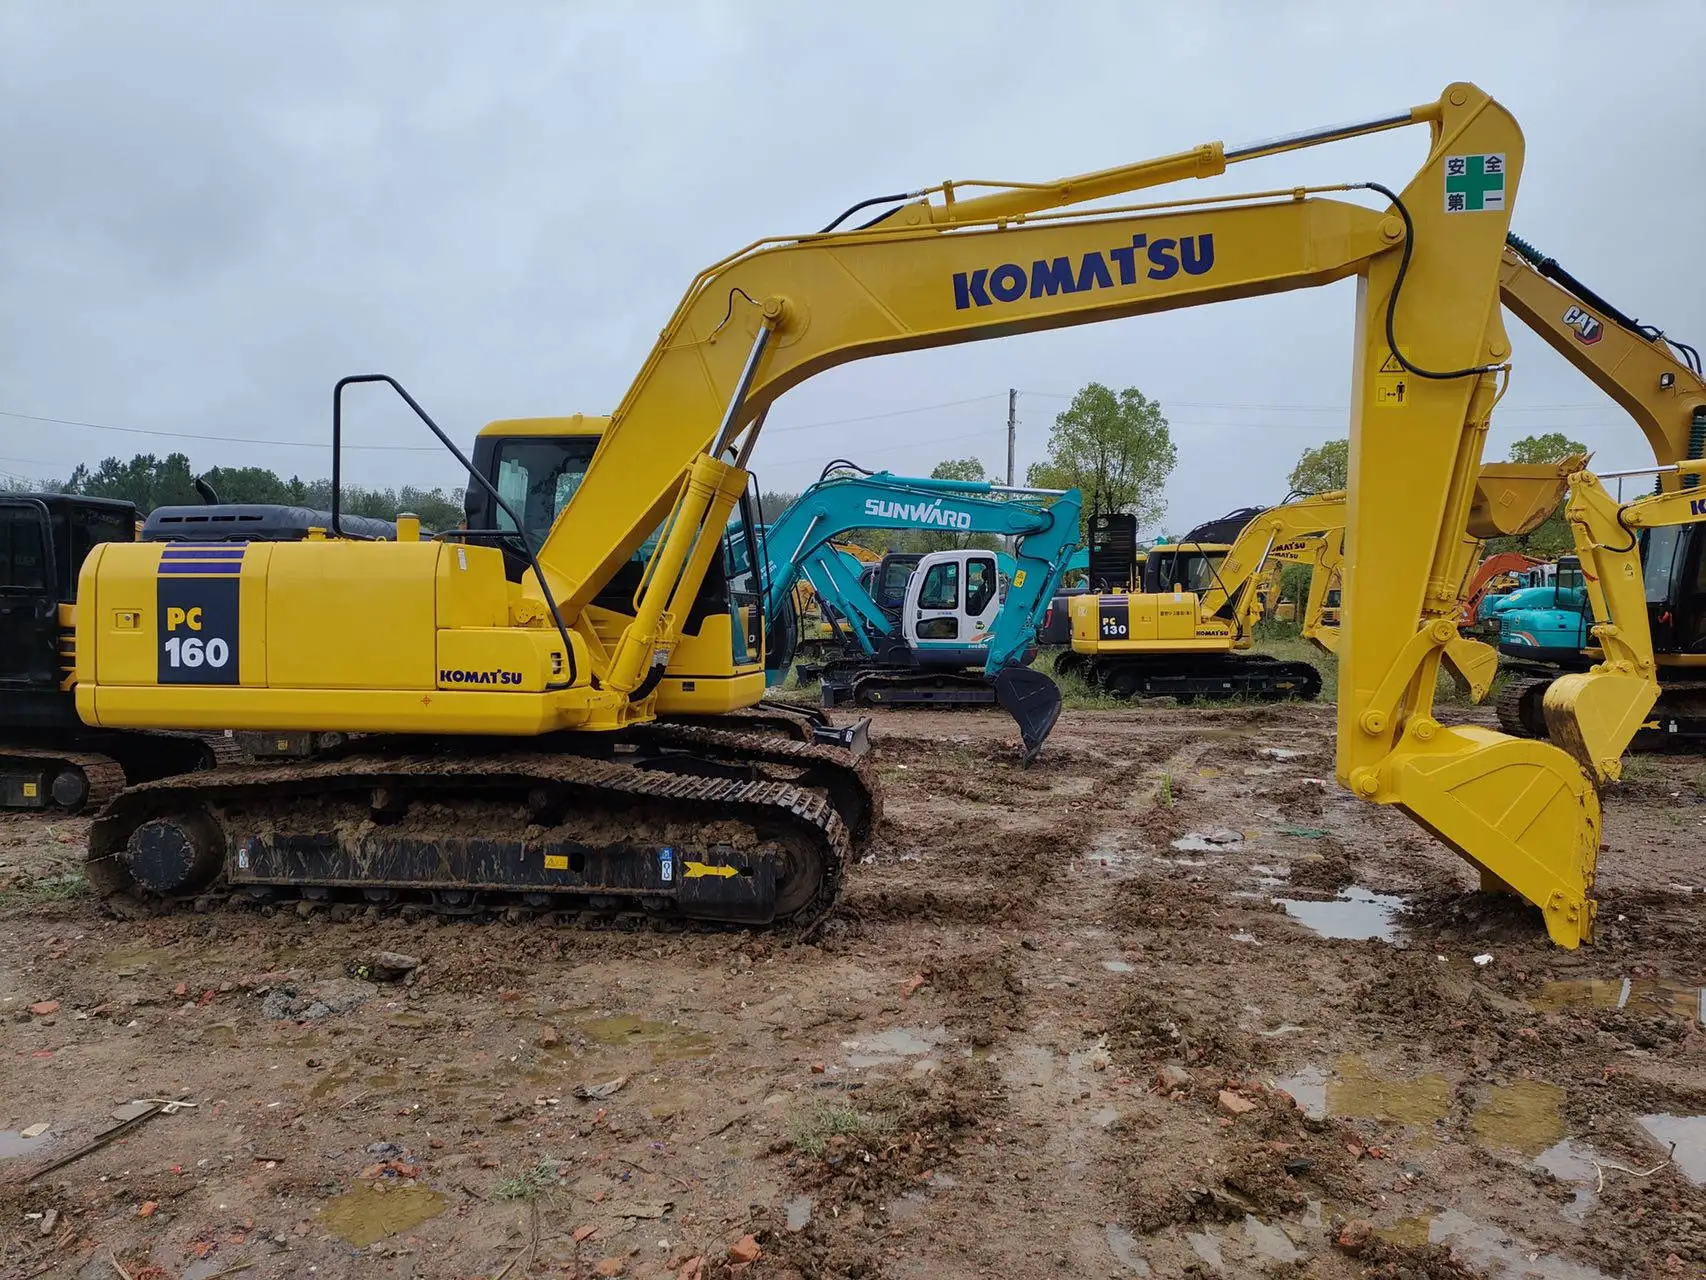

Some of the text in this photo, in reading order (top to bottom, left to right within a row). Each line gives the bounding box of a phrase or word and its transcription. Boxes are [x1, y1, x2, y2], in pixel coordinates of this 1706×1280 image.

[953, 233, 1215, 310] KOMATSU
[1562, 305, 1600, 338] CAT
[865, 498, 972, 529] SUNWARD
[1271, 541, 1306, 552] MATSU
[167, 606, 202, 631] PC
[1102, 617, 1116, 625] PC
[1102, 625, 1127, 635] 130
[165, 637, 229, 668] 160
[439, 668, 523, 685] KOMATSU
